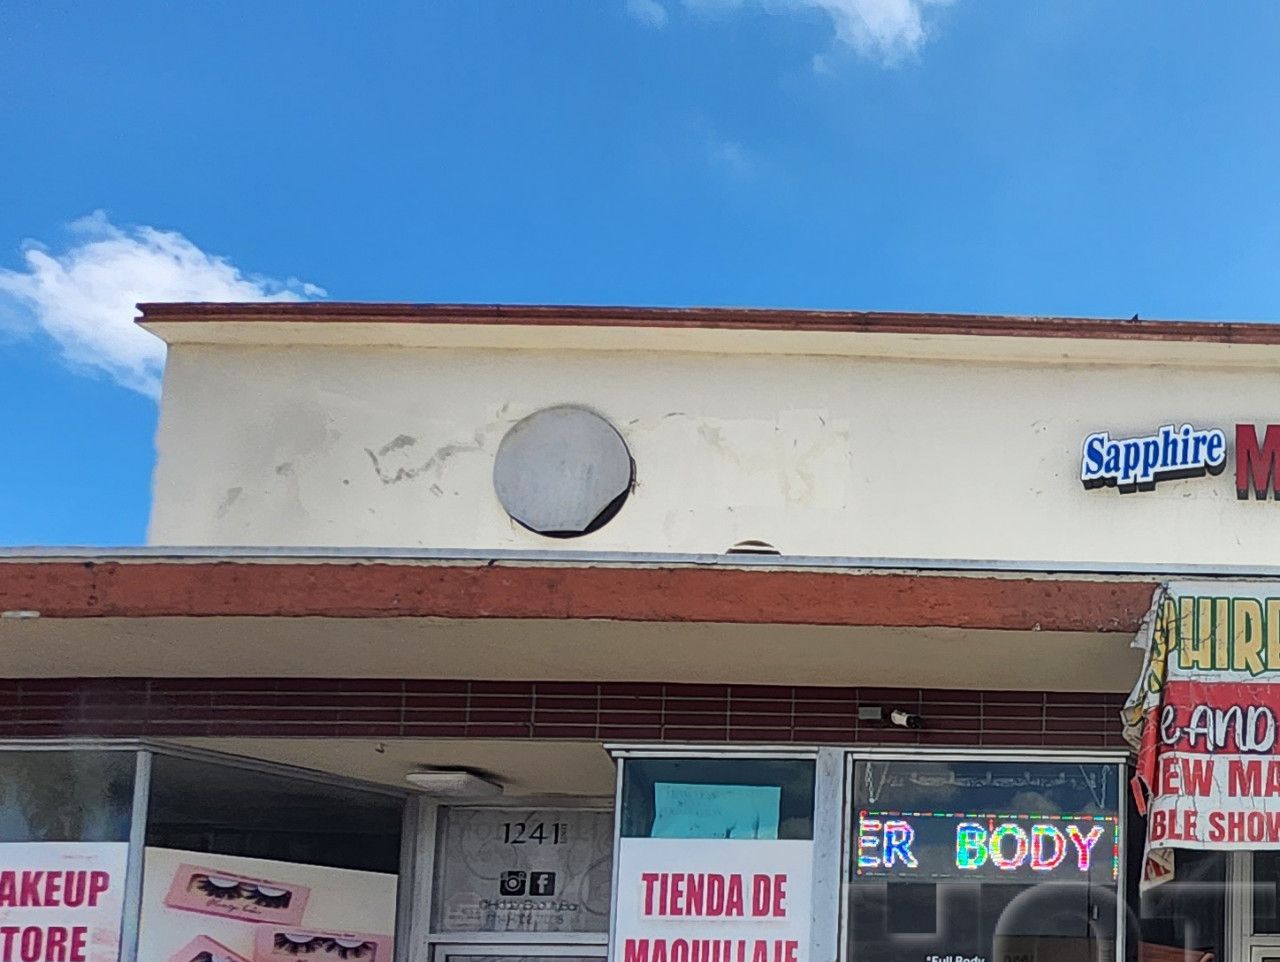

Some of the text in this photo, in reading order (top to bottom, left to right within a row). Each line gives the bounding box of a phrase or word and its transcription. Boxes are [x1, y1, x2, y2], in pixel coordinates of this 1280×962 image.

[1084, 425, 1224, 482] Sapphire
[1154, 758, 1215, 797] EW
[503, 822, 561, 845] 1241
[956, 822, 1105, 872] BODY
[0, 870, 110, 907] AKEUP
[641, 872, 788, 918] TIENDA DE
[0, 925, 88, 962] TORE
